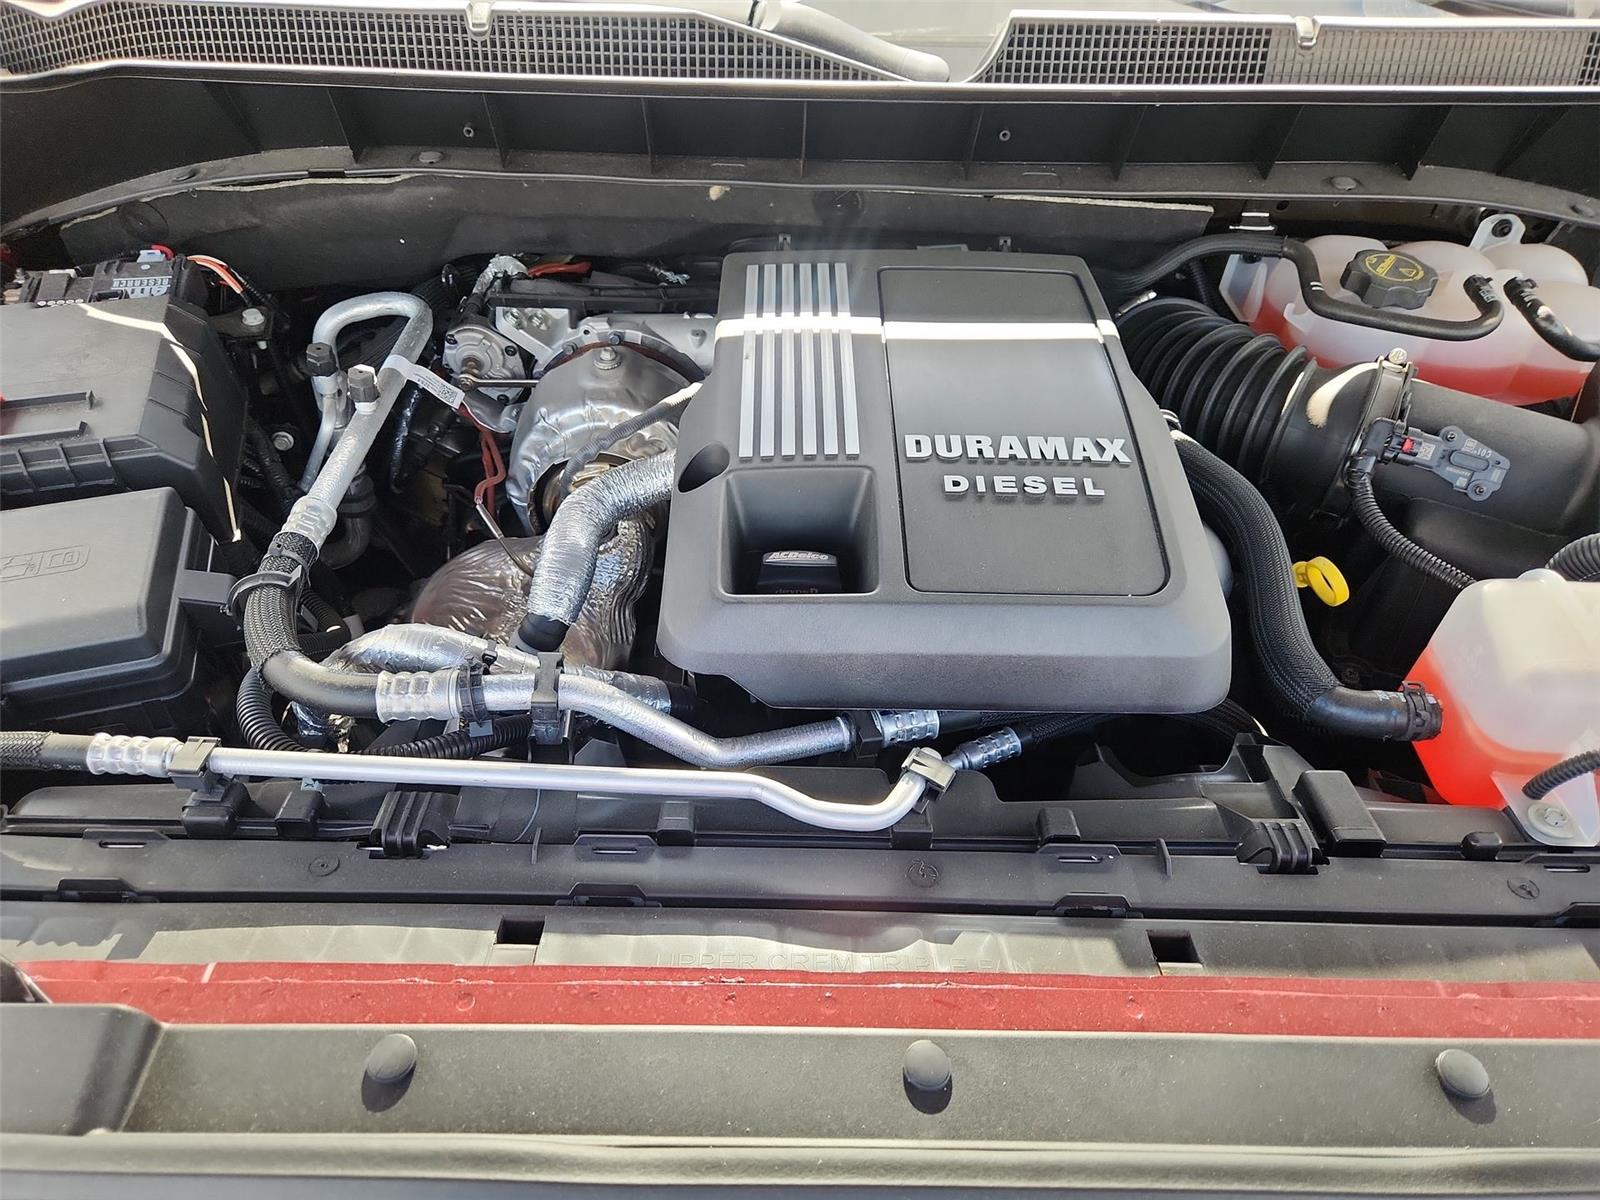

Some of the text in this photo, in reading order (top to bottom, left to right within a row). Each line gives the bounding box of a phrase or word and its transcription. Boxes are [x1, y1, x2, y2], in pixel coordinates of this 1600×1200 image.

[112, 278, 170, 288] RESEARCH
[903, 434, 1133, 464] DURAMAX
[943, 474, 1106, 496] DIESEL
[768, 551, 829, 561] ACDelco
[655, 952, 760, 968] UPPER
[860, 954, 969, 972] TRIPLE
